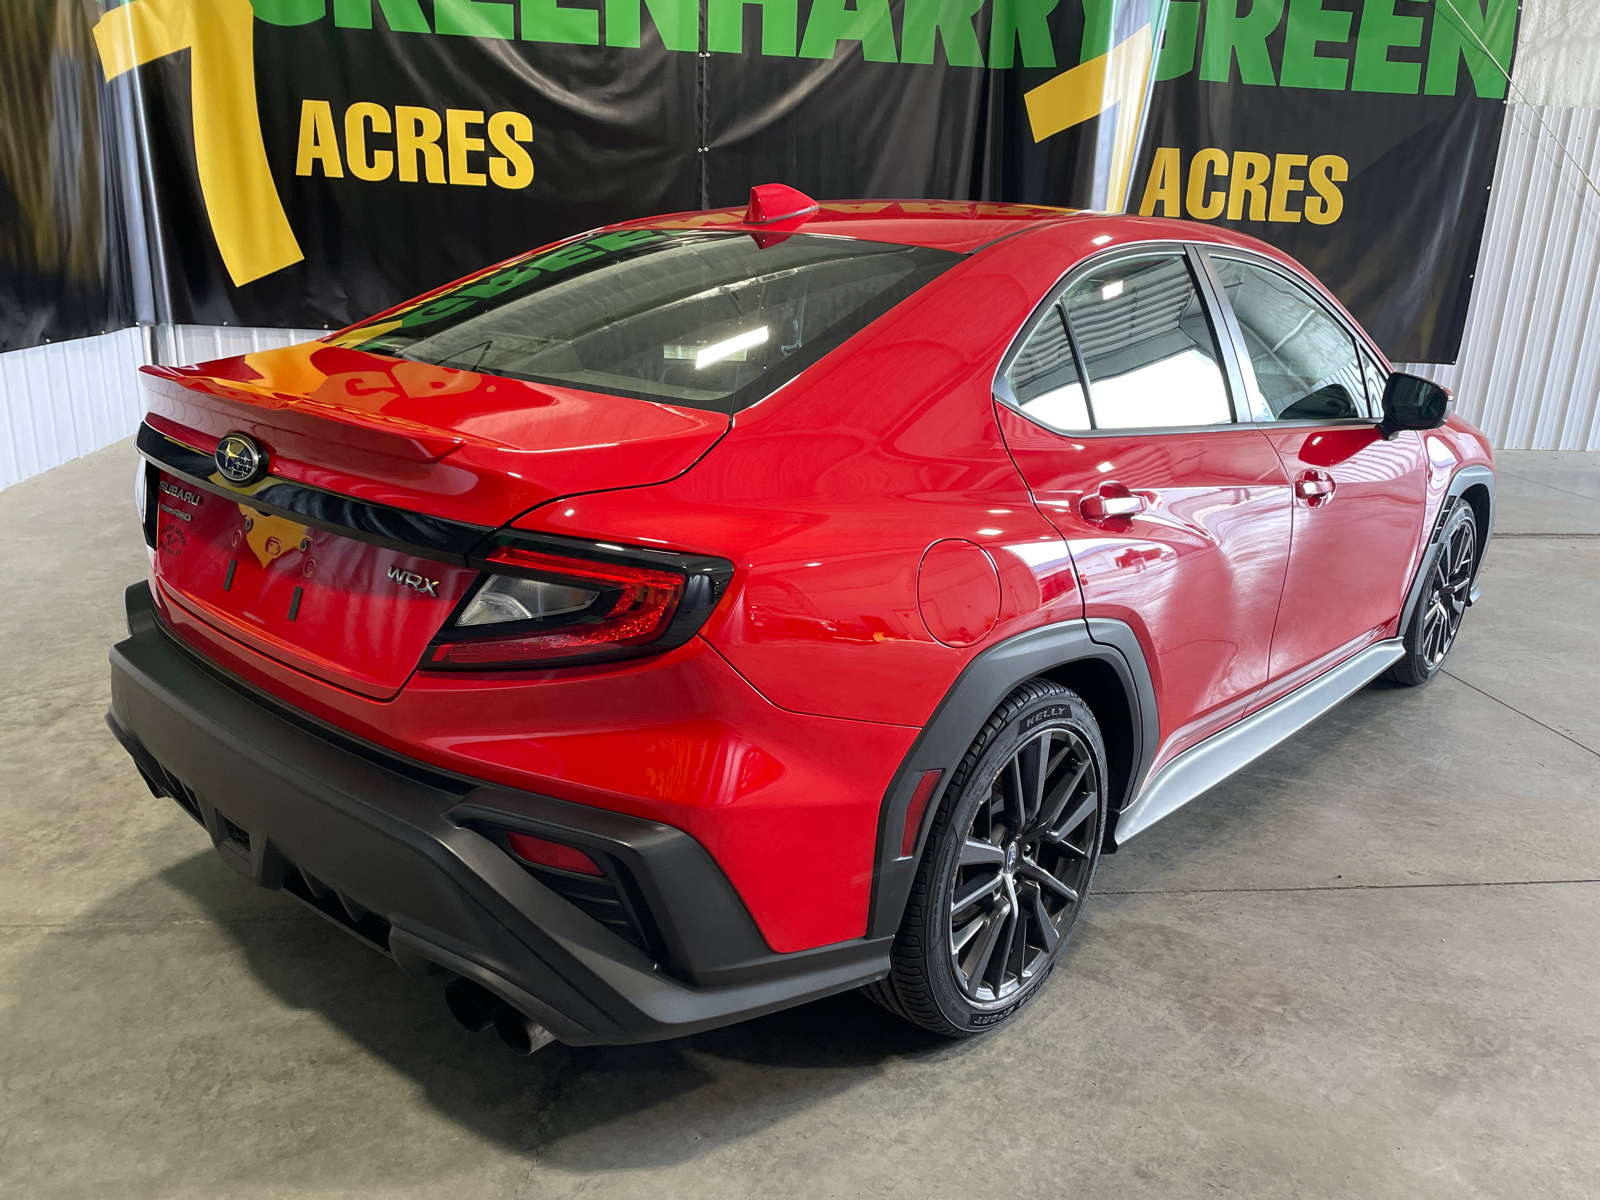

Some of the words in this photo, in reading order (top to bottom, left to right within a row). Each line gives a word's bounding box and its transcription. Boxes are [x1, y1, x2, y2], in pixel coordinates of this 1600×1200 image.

[92, 0, 305, 288] 7
[295, 98, 535, 190] ACRES
[1138, 147, 1350, 226] ACRES
[159, 481, 200, 506] SUBARU
[387, 565, 440, 597] WRX
[1026, 707, 1066, 728] KELLY
